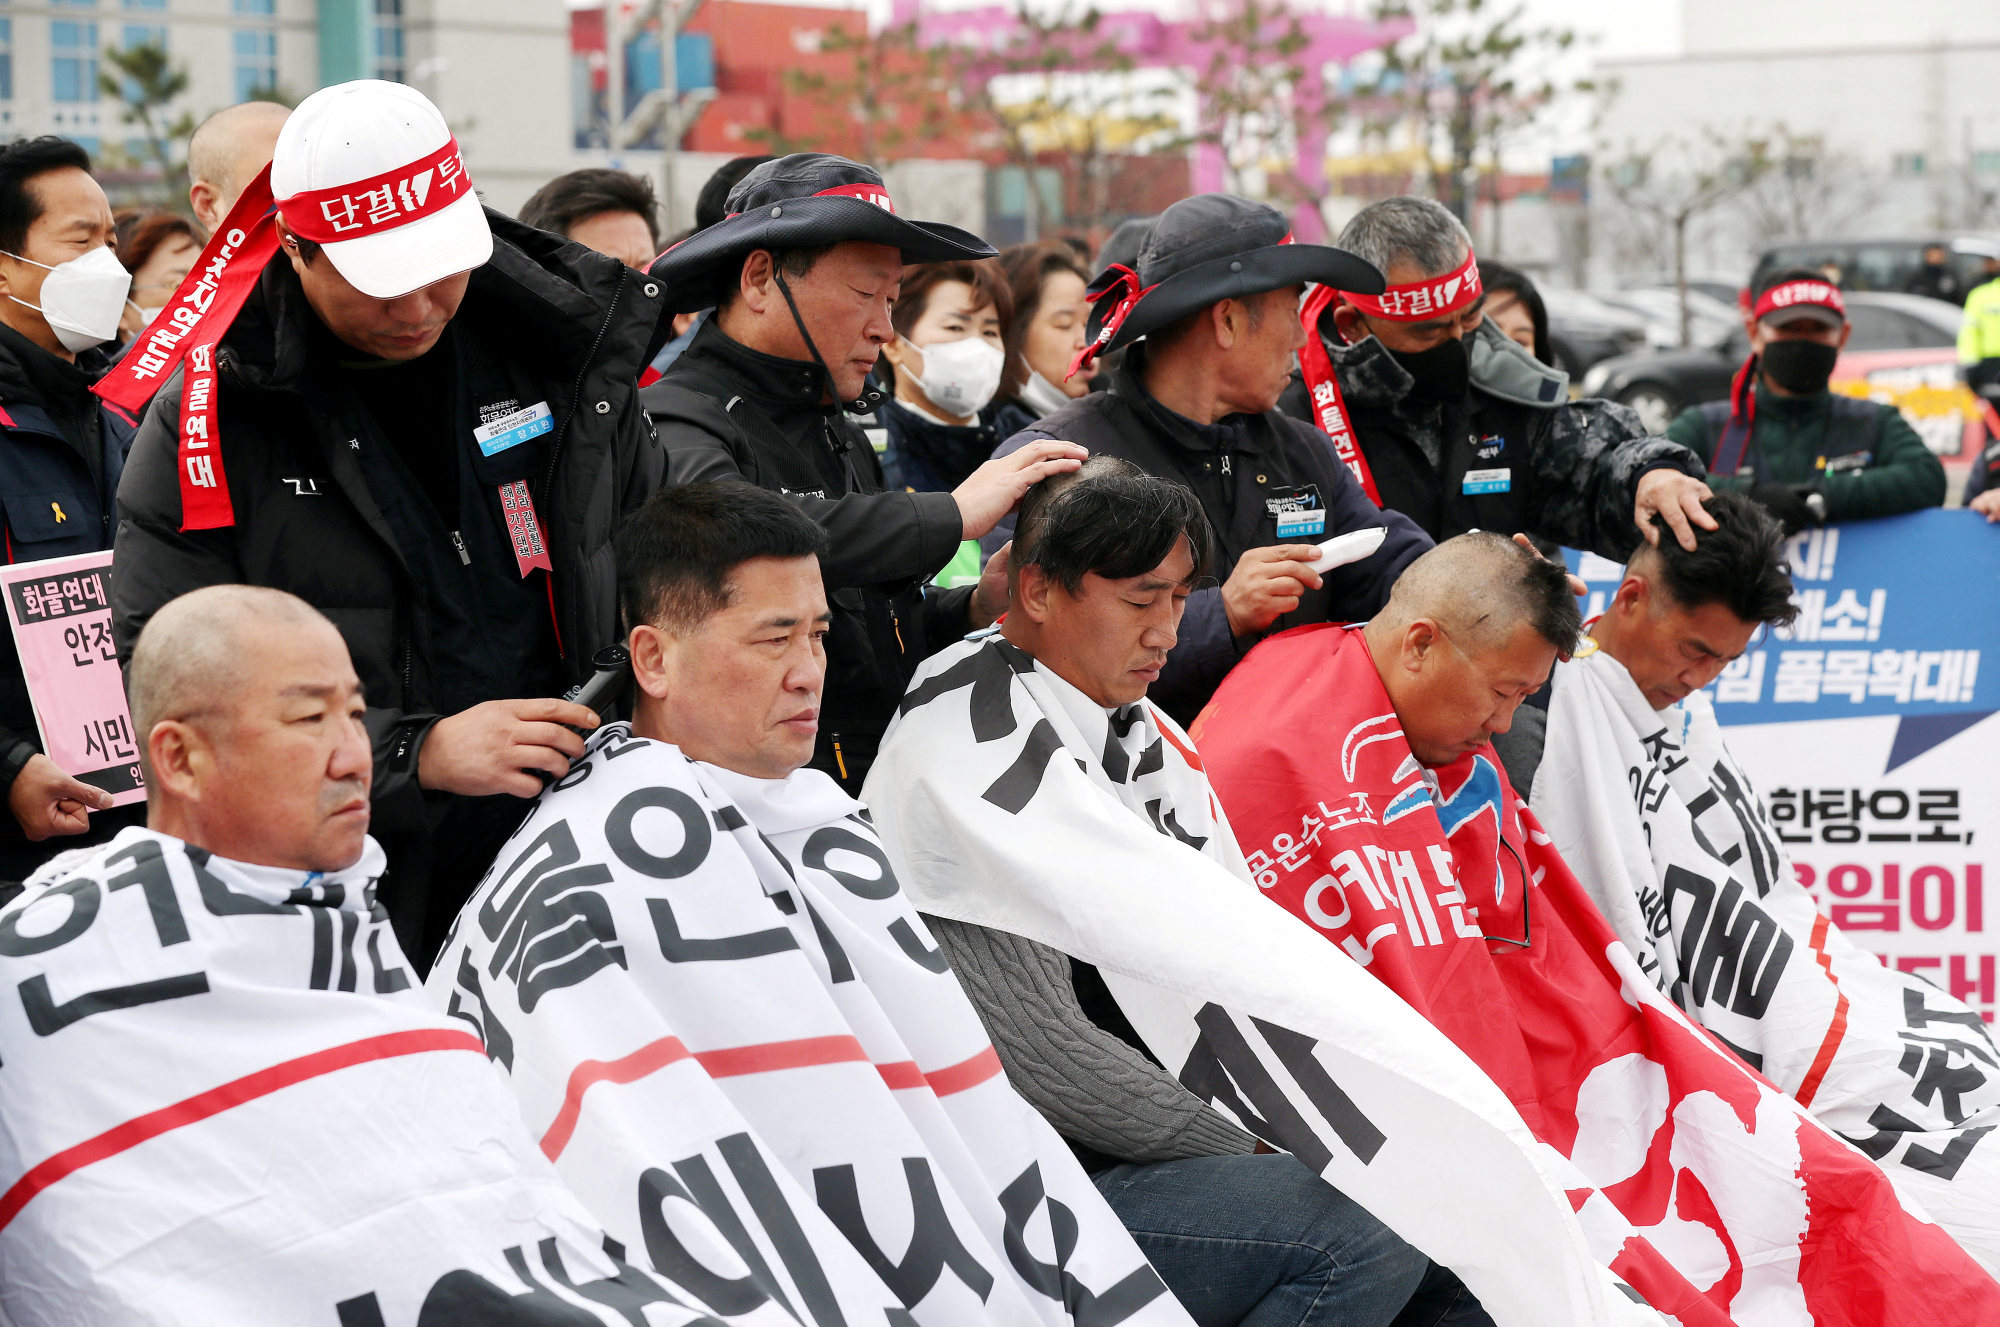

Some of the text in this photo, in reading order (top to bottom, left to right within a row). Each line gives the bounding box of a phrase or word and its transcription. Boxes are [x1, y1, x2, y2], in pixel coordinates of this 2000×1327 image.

[319, 183, 401, 233] 단결
[1379, 264, 1480, 316] 단결 투
[185, 342, 217, 488] 화물연대
[22, 573, 107, 618] 화물연대
[1704, 647, 1981, 703] 임 품목확대!
[84, 714, 134, 762] 시민
